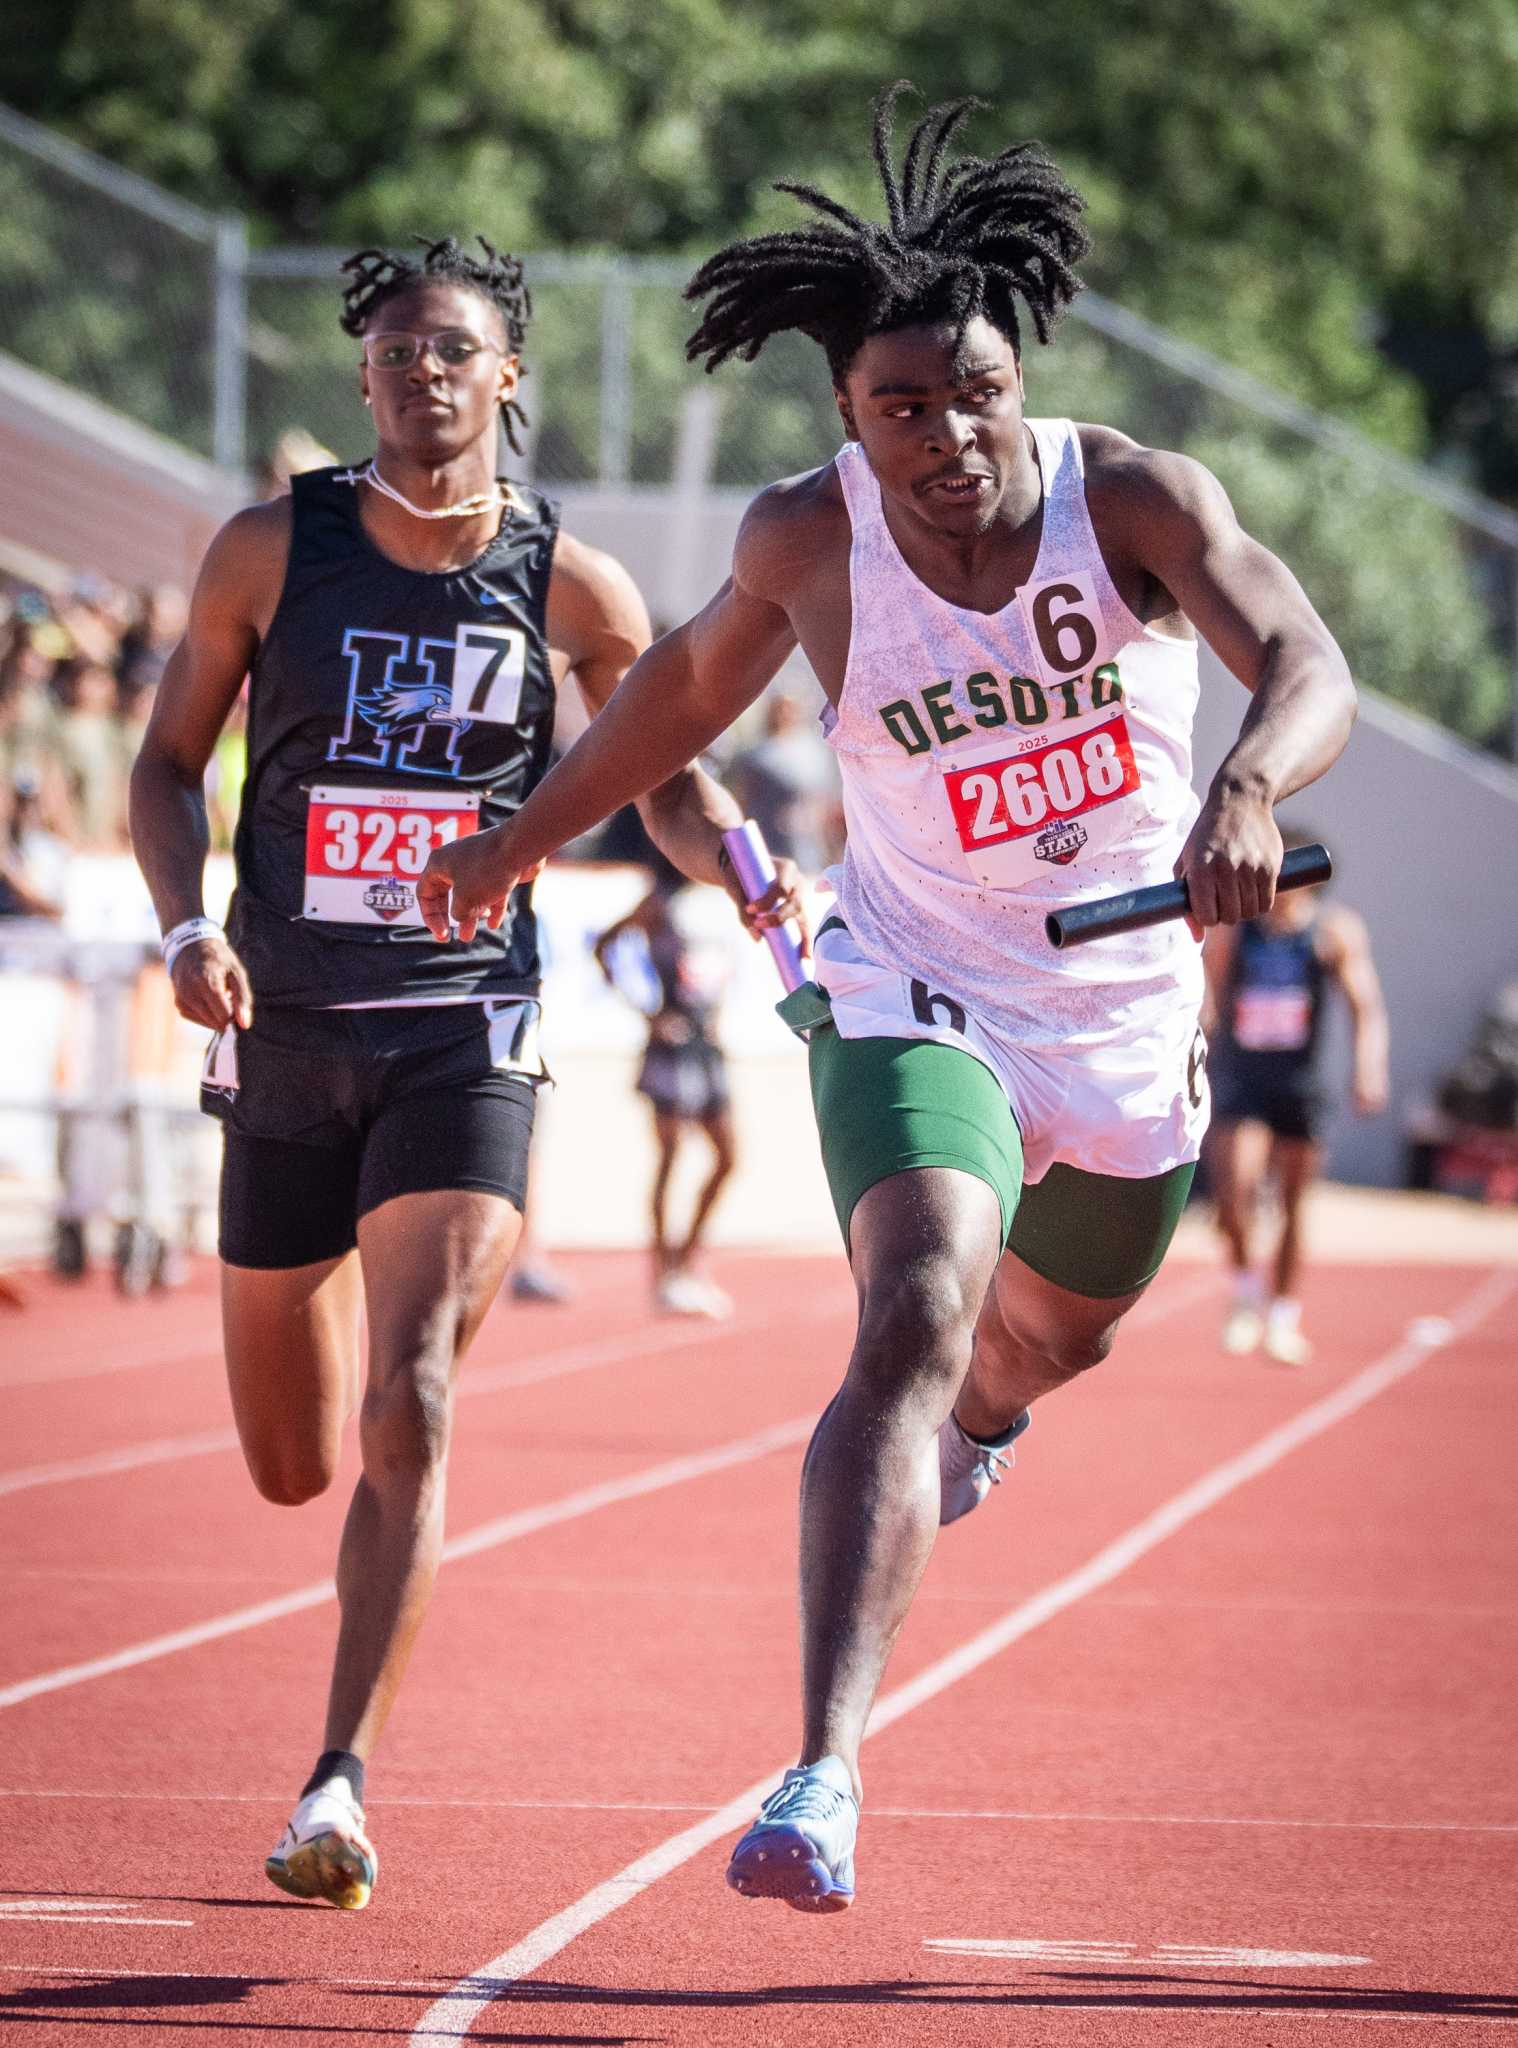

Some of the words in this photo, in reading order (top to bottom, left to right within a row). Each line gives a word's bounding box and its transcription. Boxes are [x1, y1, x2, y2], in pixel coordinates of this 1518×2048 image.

[1032, 583, 1097, 673] 6
[465, 633, 511, 713] 7
[879, 662, 1122, 756] DESOTO
[1018, 734, 1049, 752] 2025
[381, 795, 408, 806] 2025
[961, 732, 1124, 840] 2608
[1033, 828, 1087, 858] STATE
[364, 892, 413, 907] STATE
